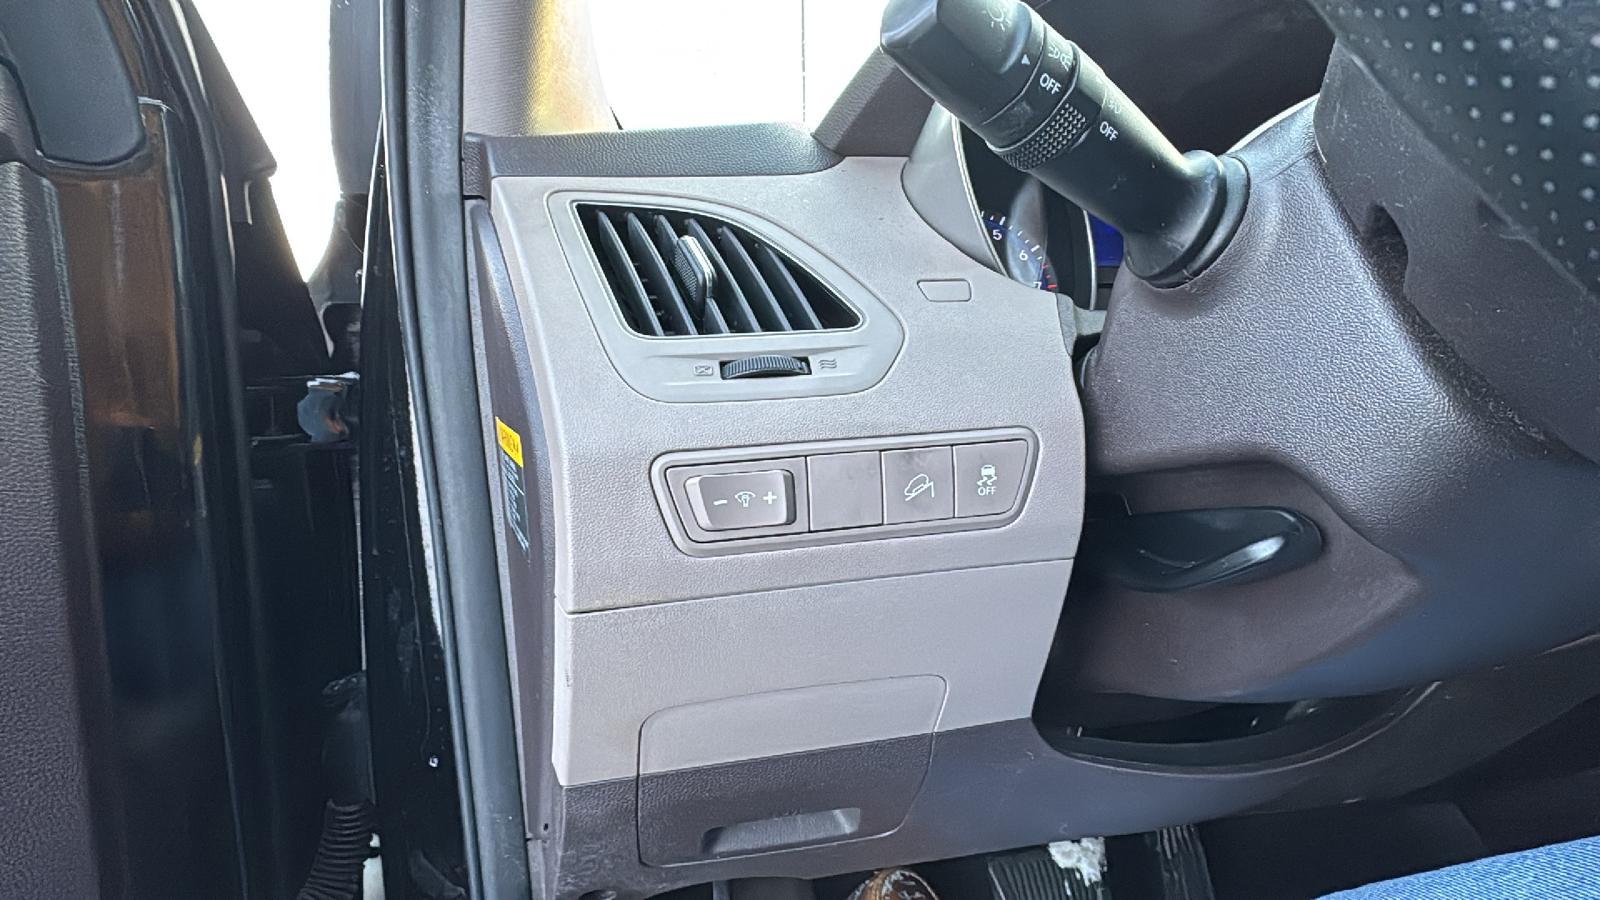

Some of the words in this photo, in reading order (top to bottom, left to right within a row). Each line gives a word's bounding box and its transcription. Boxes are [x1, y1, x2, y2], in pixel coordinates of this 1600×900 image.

[1040, 73, 1061, 94] OFF
[1100, 121, 1118, 141] OFF
[992, 229, 1002, 240] 5
[1019, 250, 1028, 260] 6
[977, 486, 996, 496] OFF
